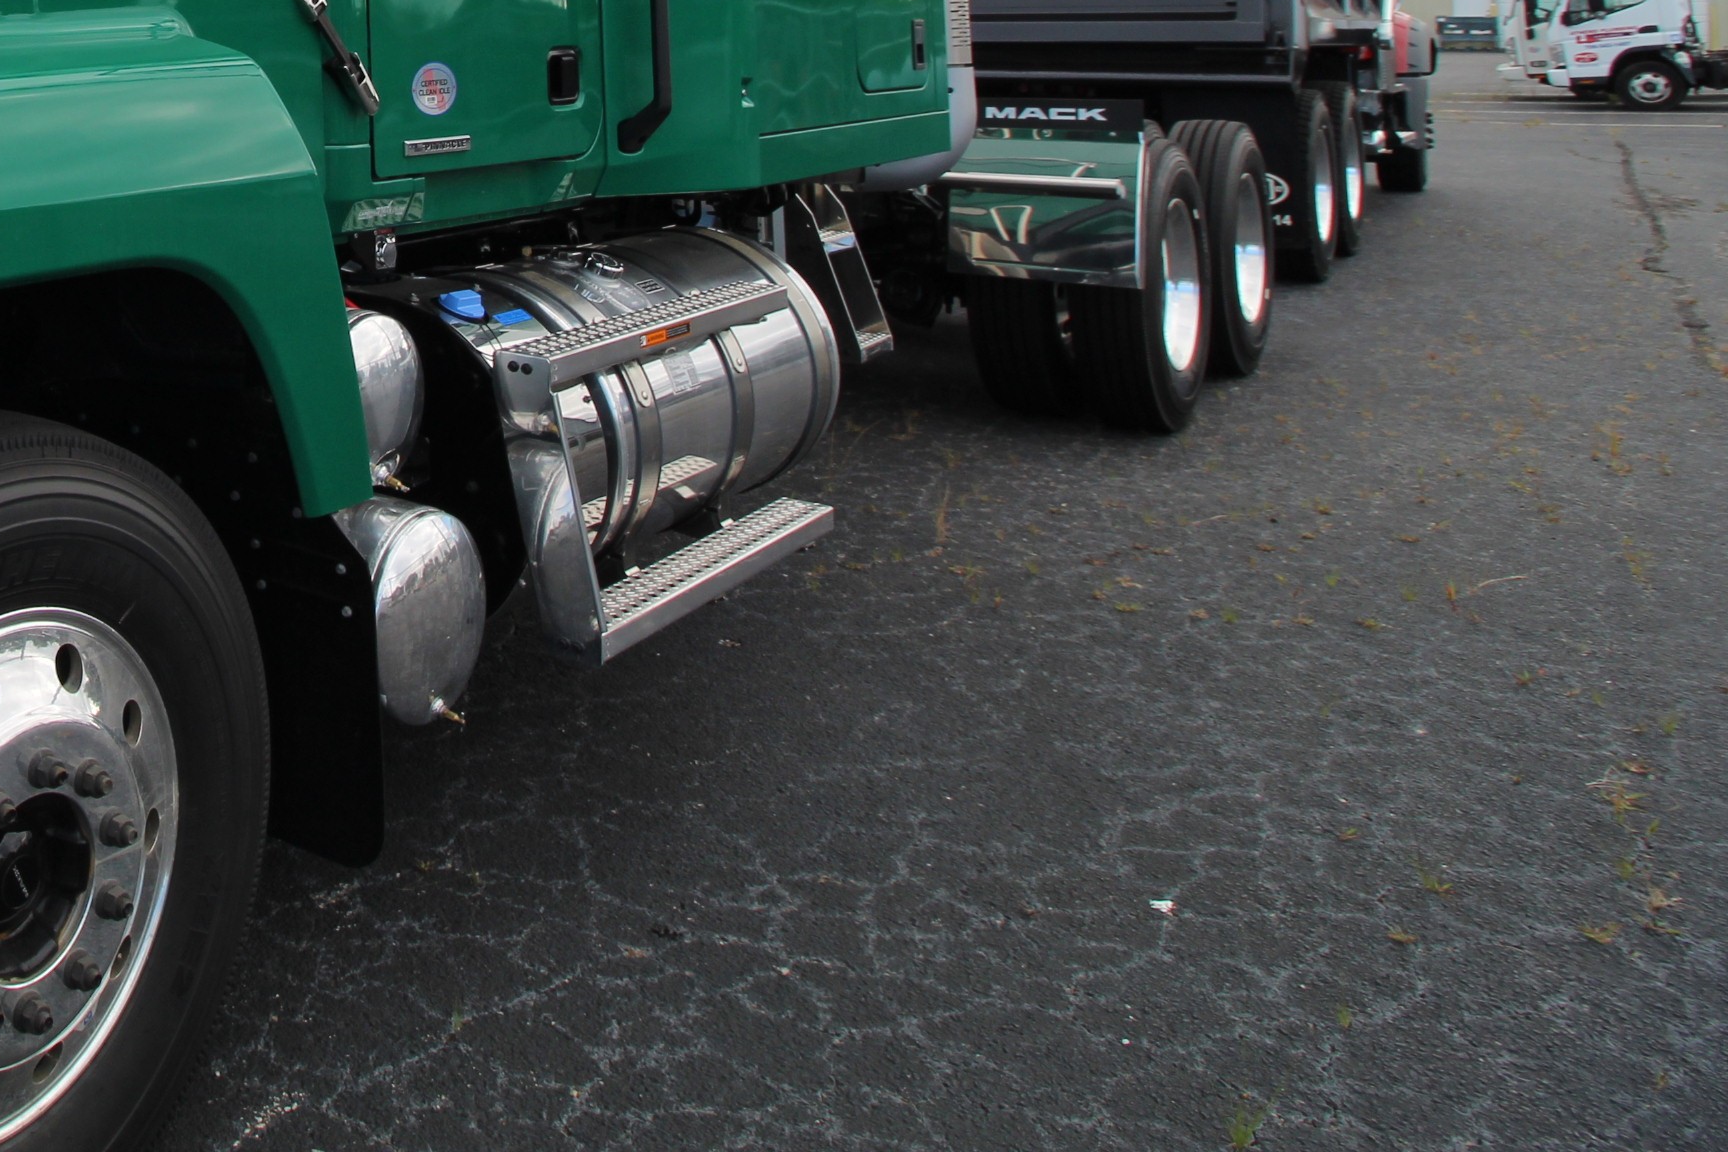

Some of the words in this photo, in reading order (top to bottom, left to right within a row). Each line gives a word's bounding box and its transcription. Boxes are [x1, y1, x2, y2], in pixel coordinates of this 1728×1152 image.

[421, 79, 448, 87] CERTIFIED
[419, 88, 437, 96] CLEAN
[984, 106, 1108, 122] MACK
